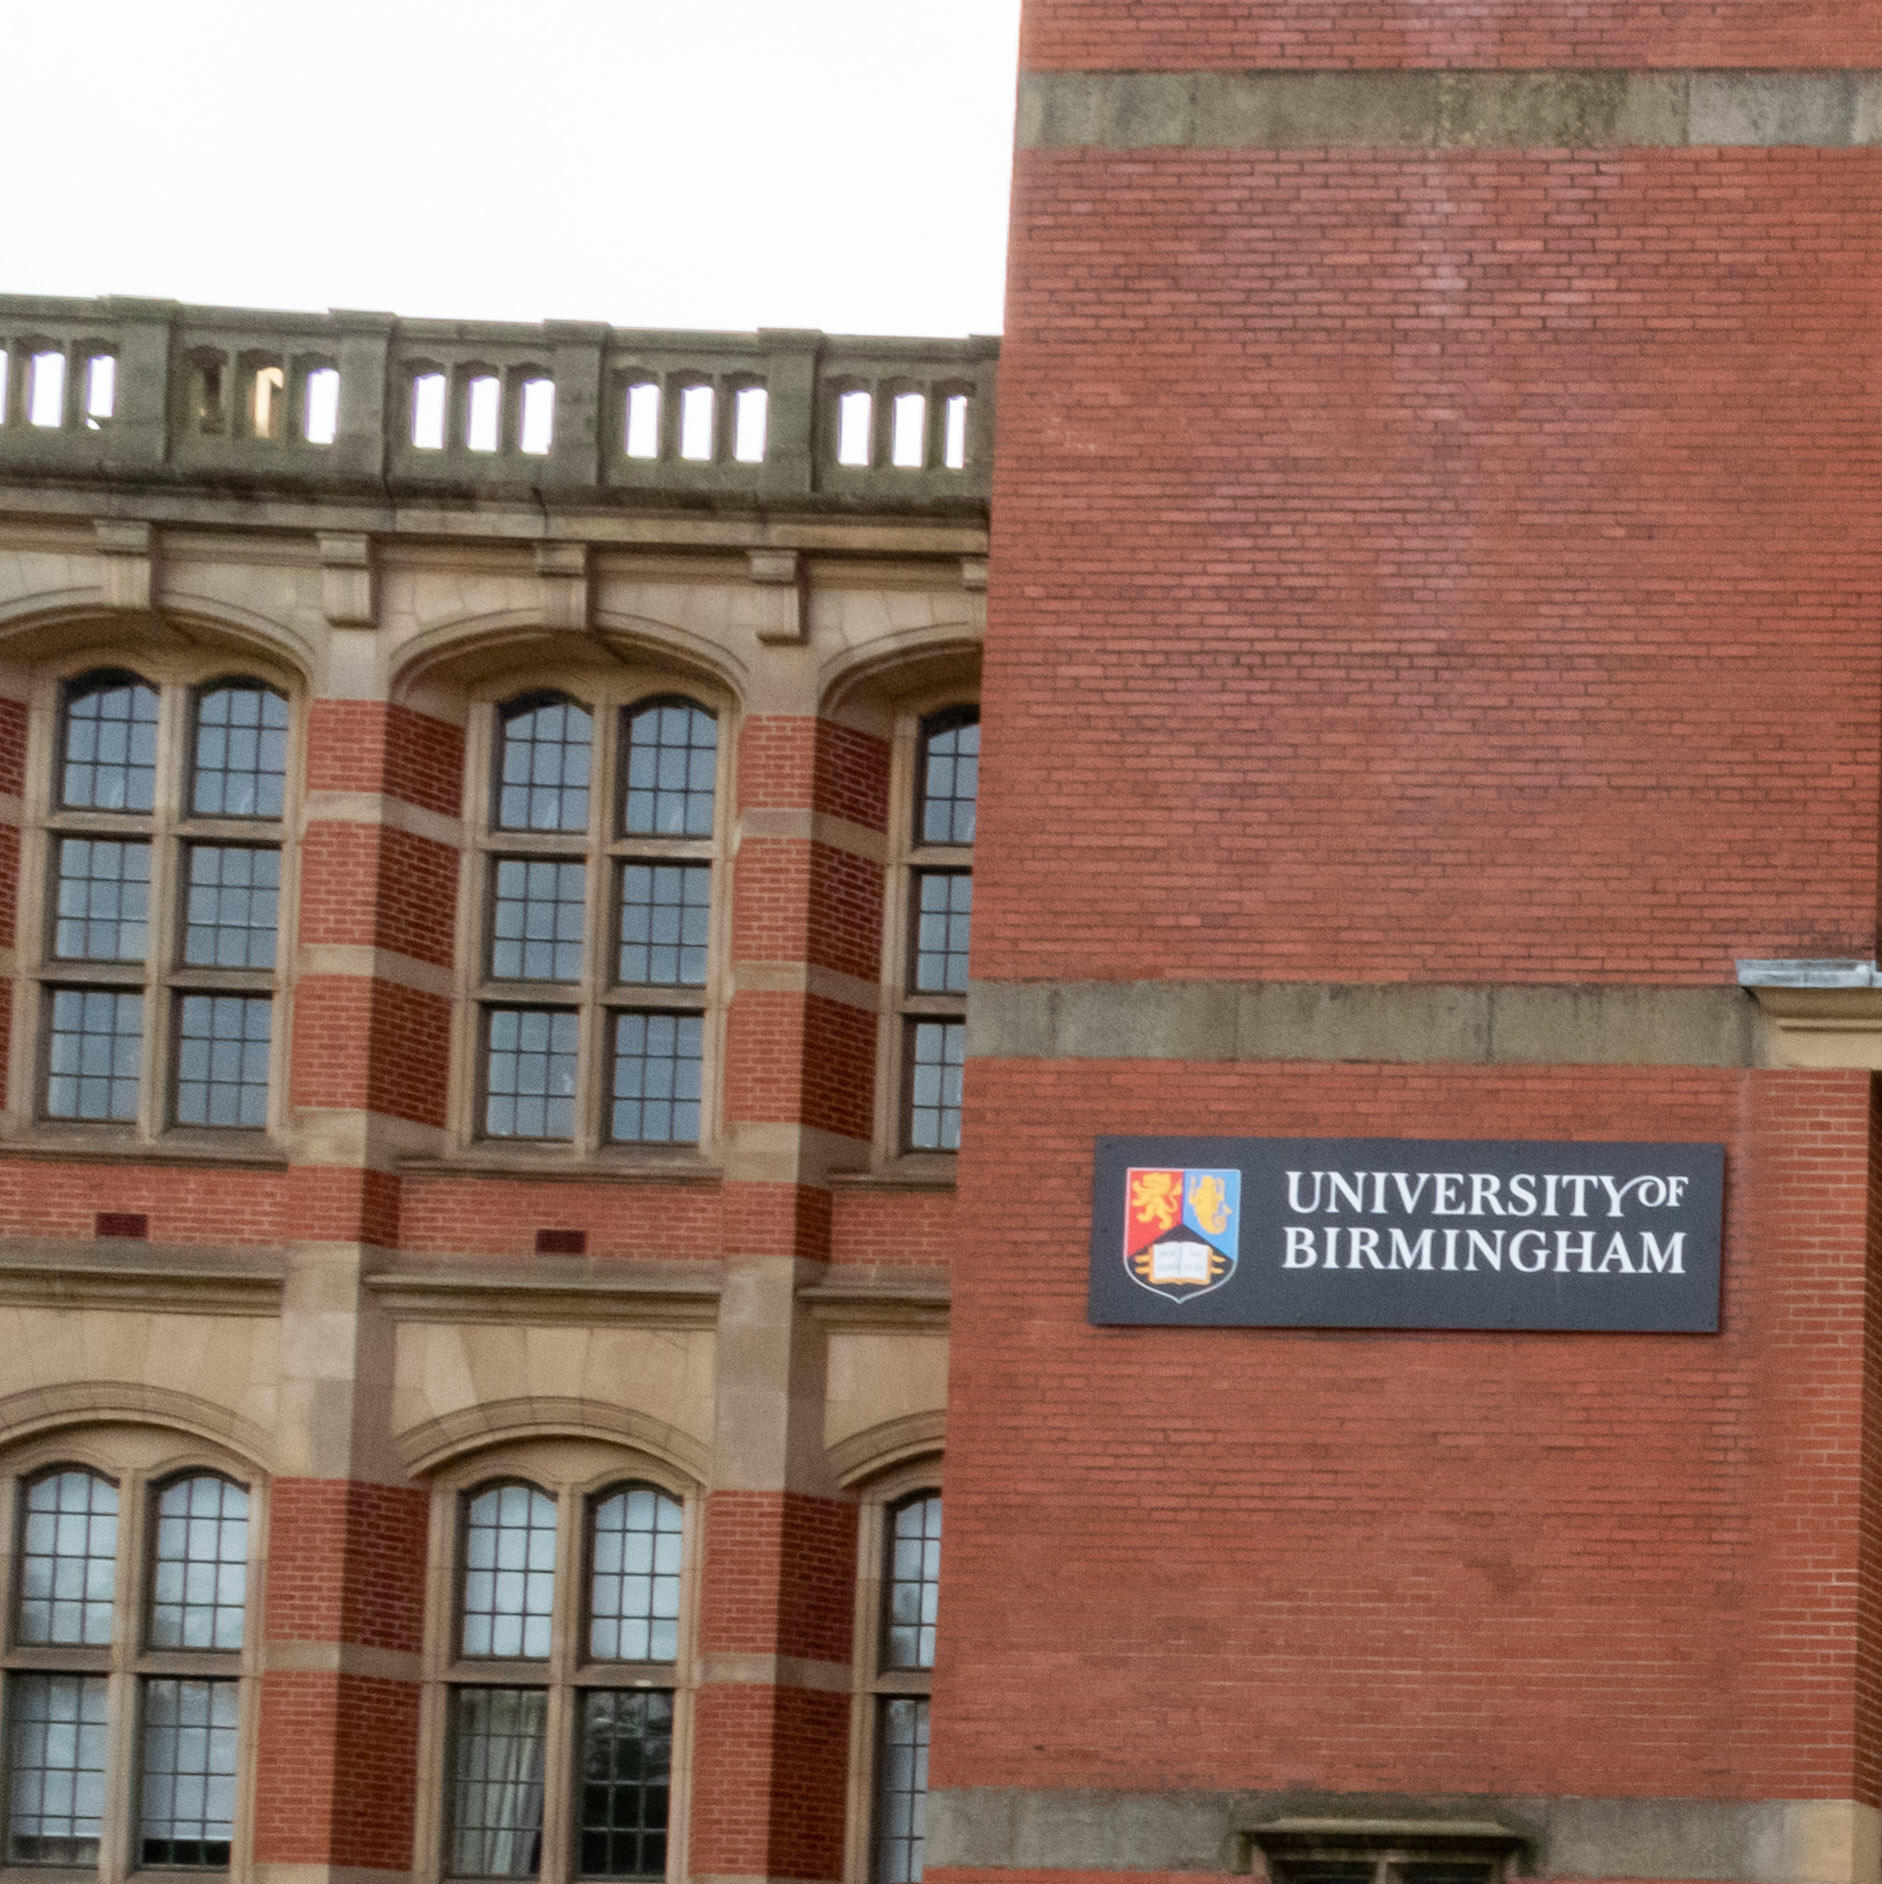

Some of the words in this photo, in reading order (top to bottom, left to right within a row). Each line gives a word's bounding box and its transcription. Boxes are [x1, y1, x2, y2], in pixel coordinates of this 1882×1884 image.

[1284, 1170, 1638, 1218] UNIVERSITY
[1637, 1174, 1689, 1208] OF
[1281, 1226, 1687, 1275] BIRMINGHAM
